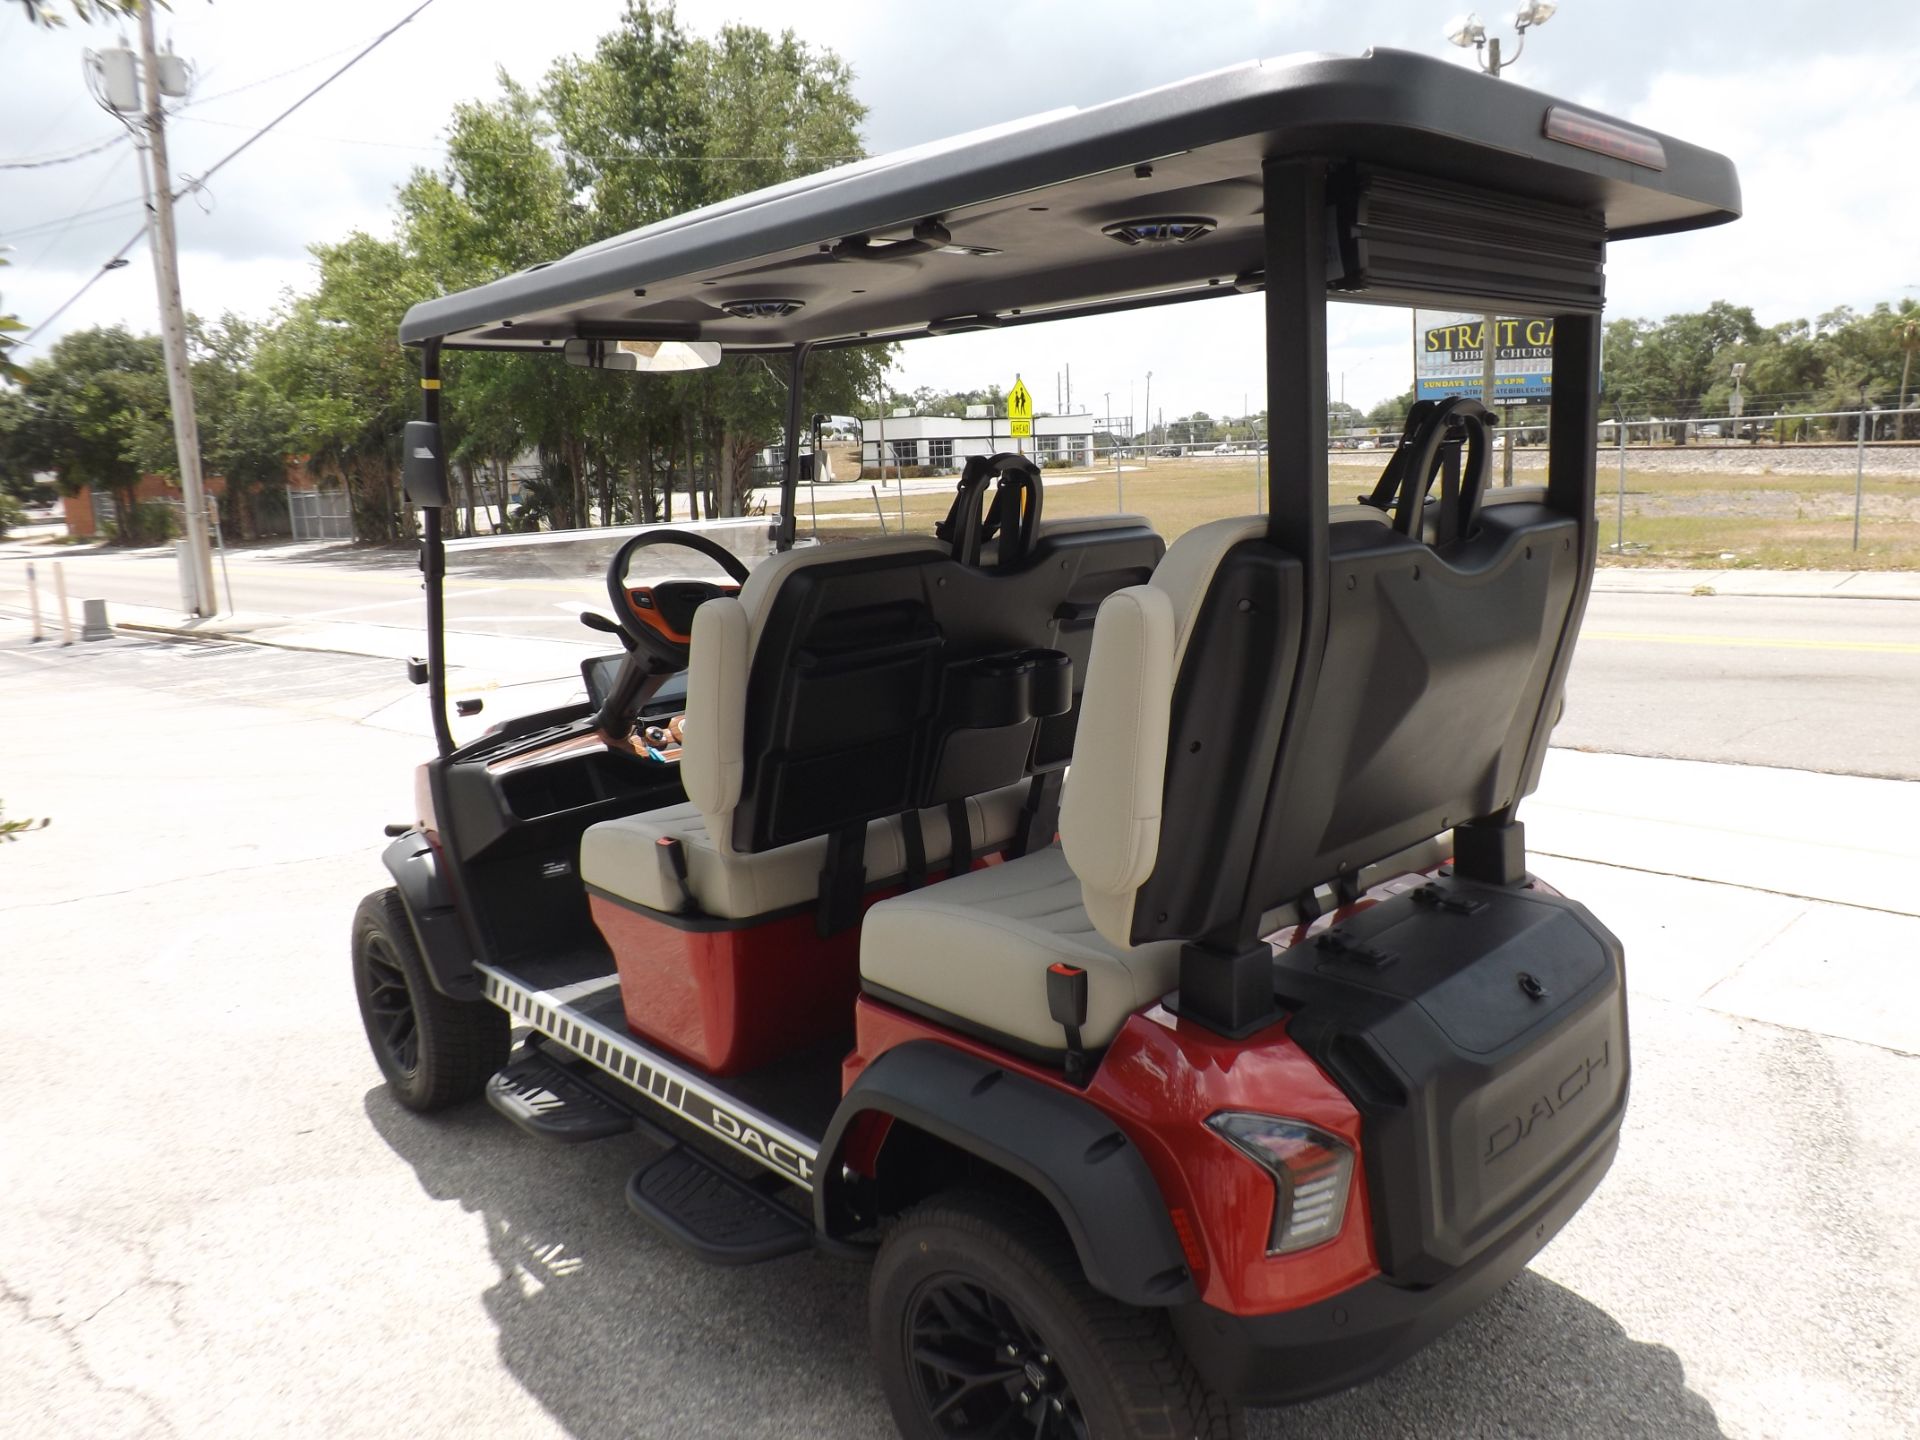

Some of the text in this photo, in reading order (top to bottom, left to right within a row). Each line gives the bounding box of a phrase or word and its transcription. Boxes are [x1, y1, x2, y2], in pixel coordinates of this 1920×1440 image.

[1427, 321, 1518, 351] STRAIT
[1424, 380, 1464, 388] SUNDAYS
[1013, 424, 1028, 434] AHEAD
[1484, 1040, 1609, 1166] DACH
